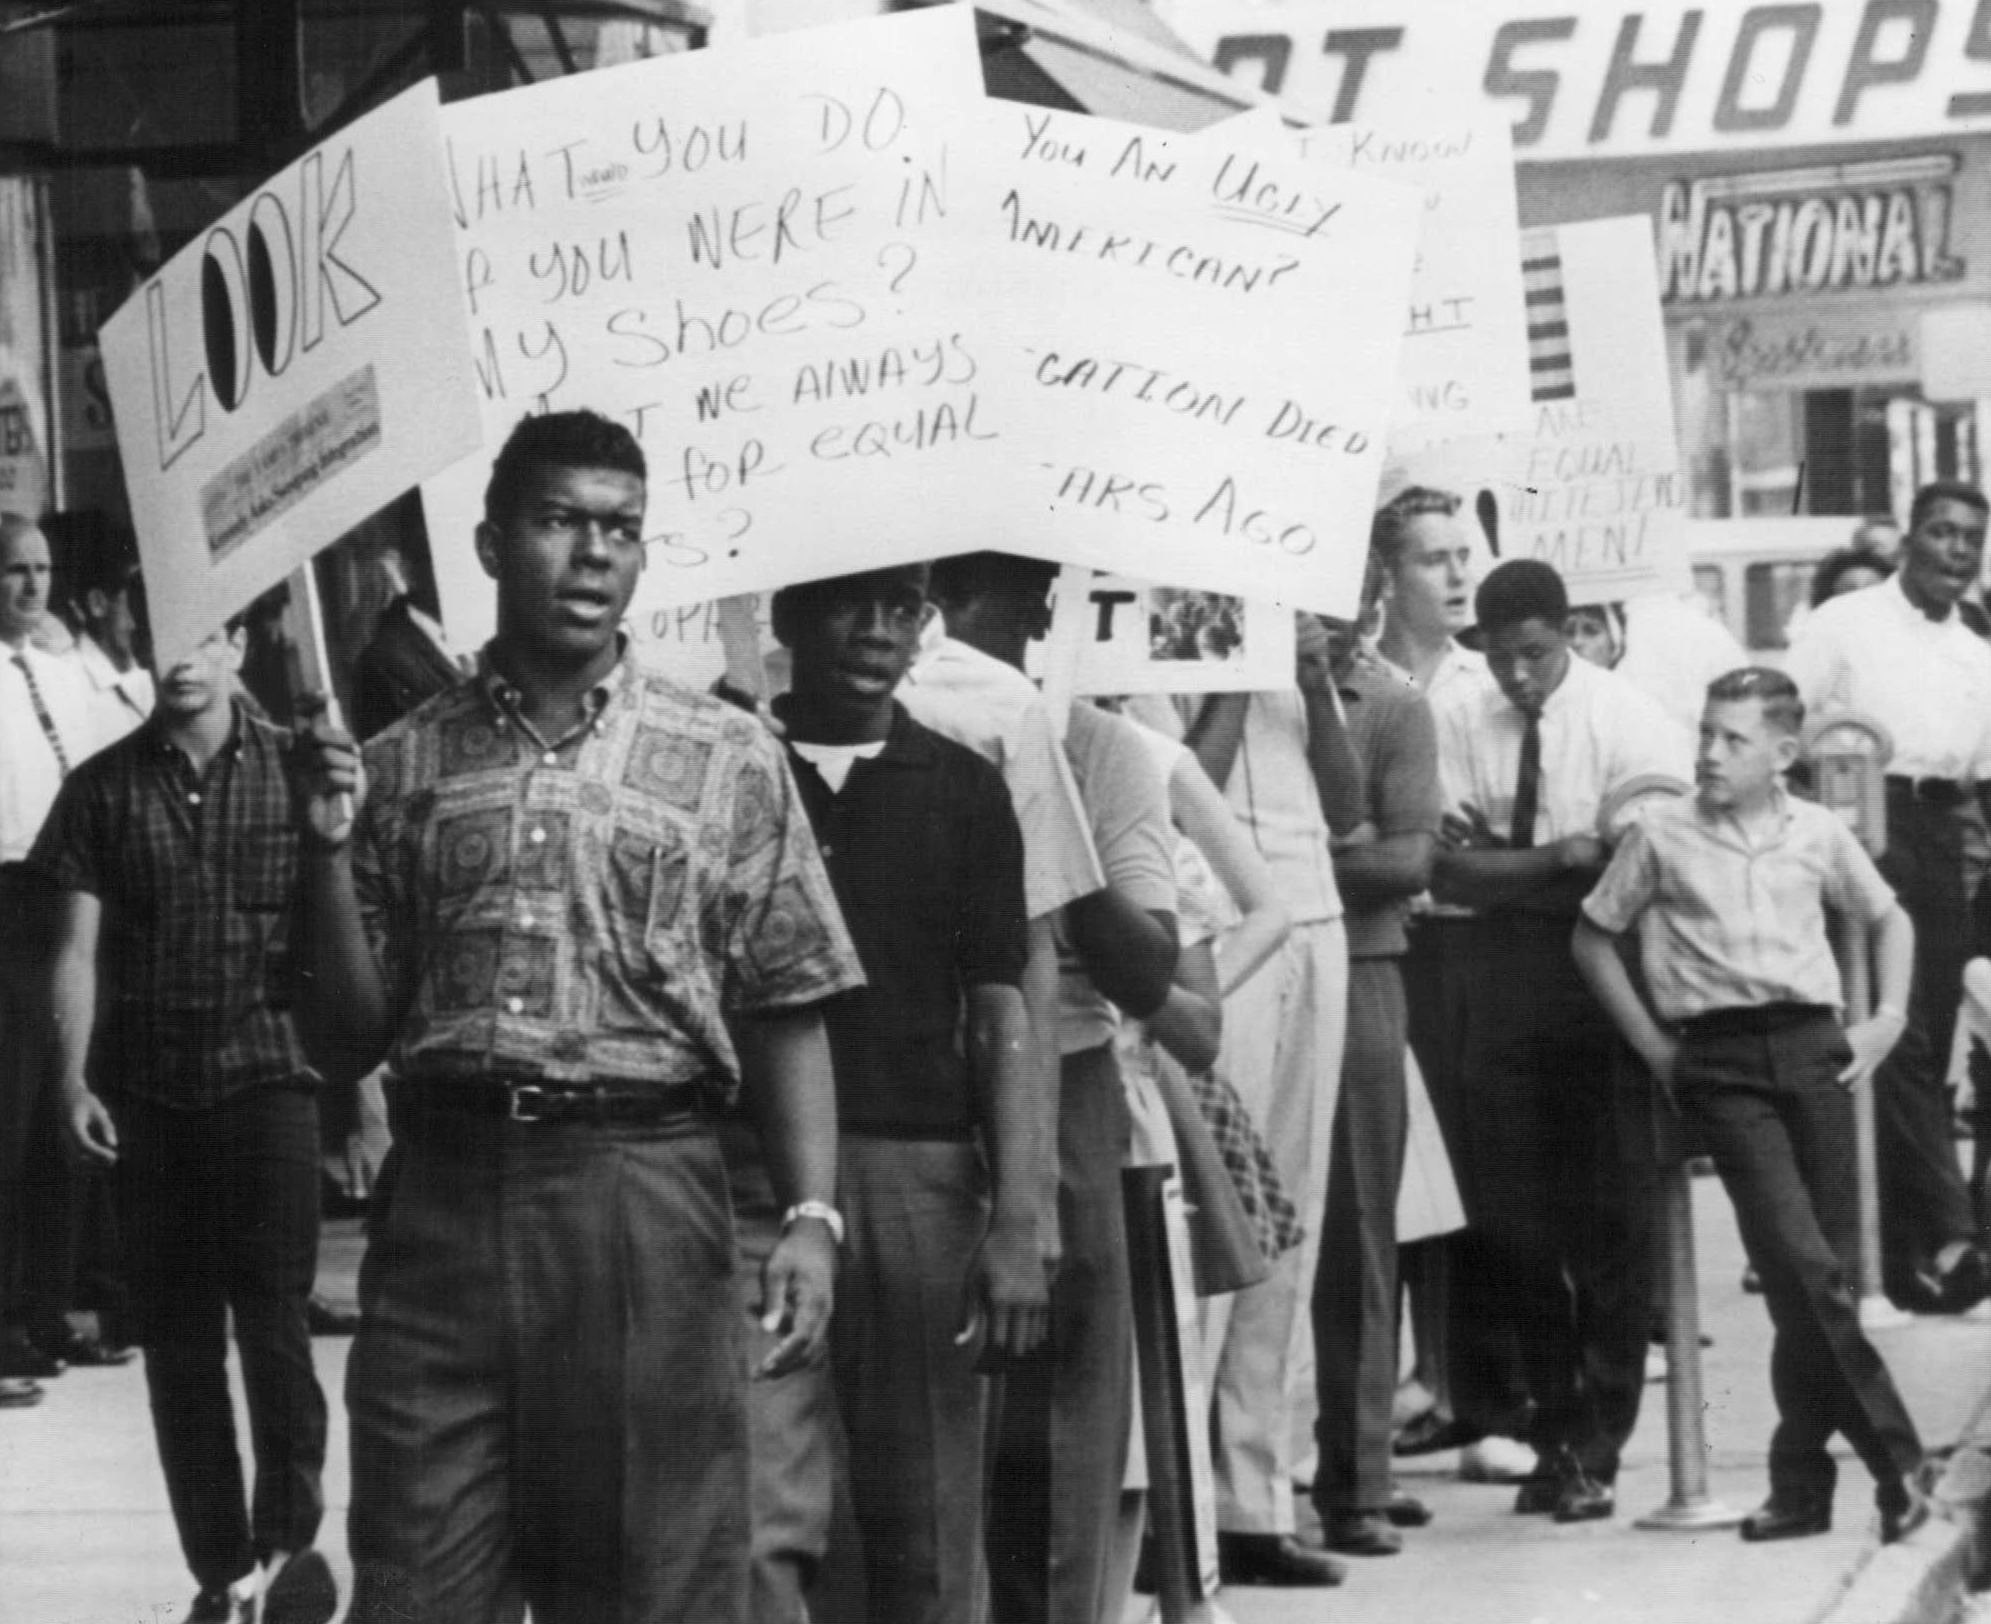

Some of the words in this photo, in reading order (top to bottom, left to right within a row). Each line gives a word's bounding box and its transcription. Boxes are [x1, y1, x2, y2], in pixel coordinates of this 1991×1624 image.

[633, 117, 747, 178] YOU
[801, 86, 904, 154] DO
[1212, 153, 1342, 238] UGLY
[1660, 158, 1965, 302] NATIONAL
[146, 147, 383, 472] LOOK
[529, 228, 632, 303] YOU
[606, 242, 918, 368] Shoes?
[1193, 475, 1317, 556] AGO
